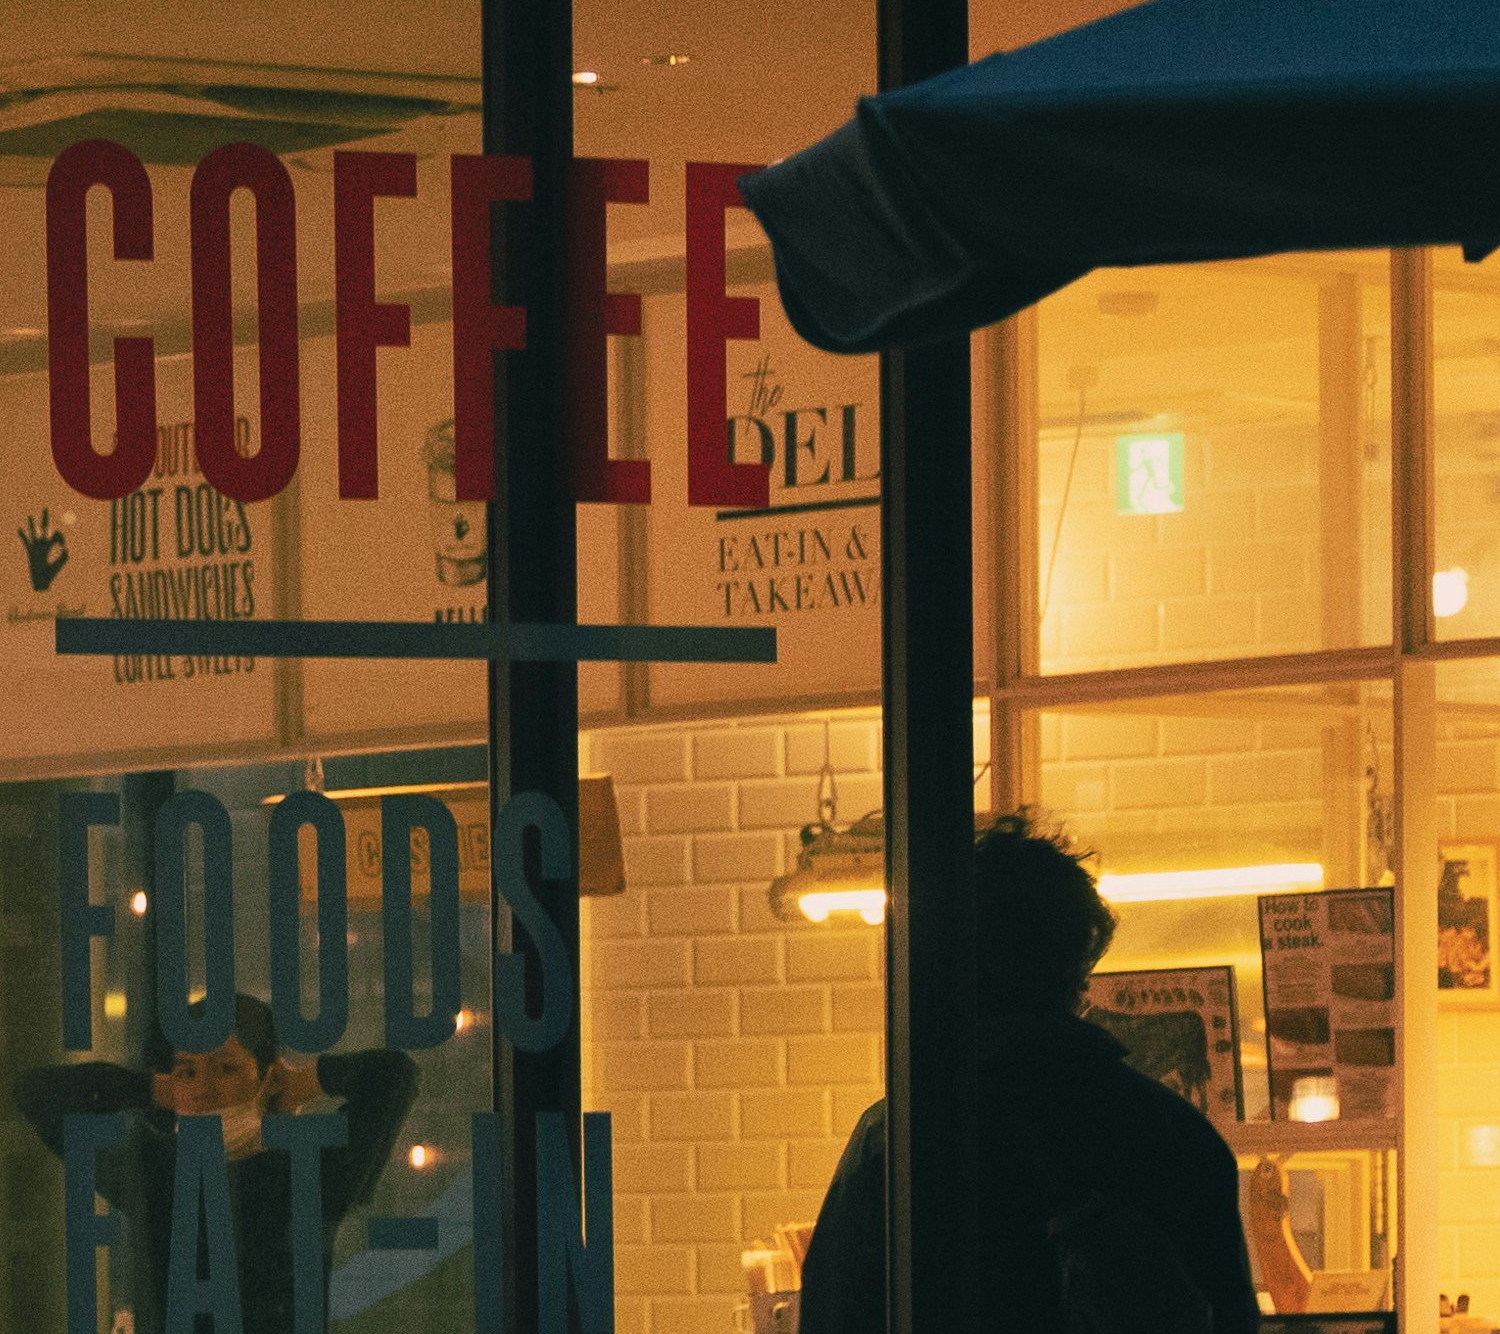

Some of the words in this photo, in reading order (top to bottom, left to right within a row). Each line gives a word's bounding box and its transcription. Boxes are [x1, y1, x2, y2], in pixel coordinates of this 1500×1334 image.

[46, 138, 771, 508] COFFEE
[110, 487, 163, 565] HOT
[175, 483, 252, 559] DOGS
[845, 525, 869, 562] &
[110, 561, 255, 620] SANDWICHES
[716, 570, 881, 616] TAKEAW
[60, 788, 575, 1055] FOODS
[1273, 916, 1312, 933] cook
